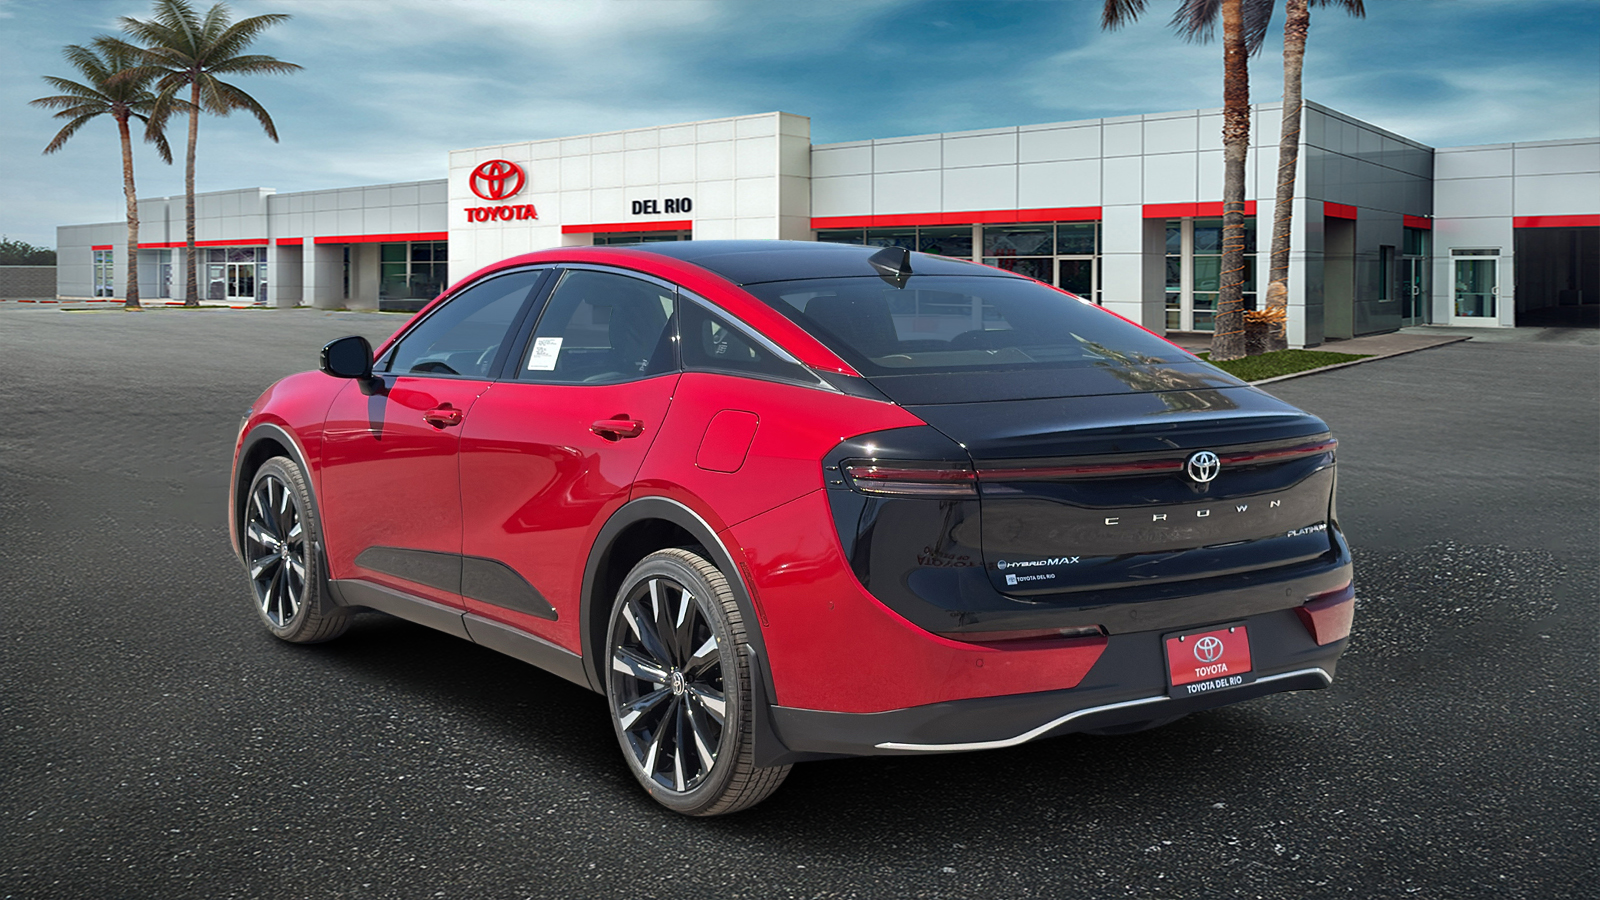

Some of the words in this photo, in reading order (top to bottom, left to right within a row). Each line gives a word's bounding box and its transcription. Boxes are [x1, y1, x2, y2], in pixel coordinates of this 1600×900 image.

[464, 203, 538, 223] TOYOTA
[632, 200, 661, 215] DEL
[664, 197, 693, 214] RIO
[1104, 500, 1281, 526] CROWN
[1016, 574, 1036, 582] TOYOTA
[1195, 663, 1227, 677] TOYOTA
[1187, 681, 1215, 693] TOYOTA
[1216, 679, 1229, 688] DEL
[1230, 676, 1242, 685] RIO
